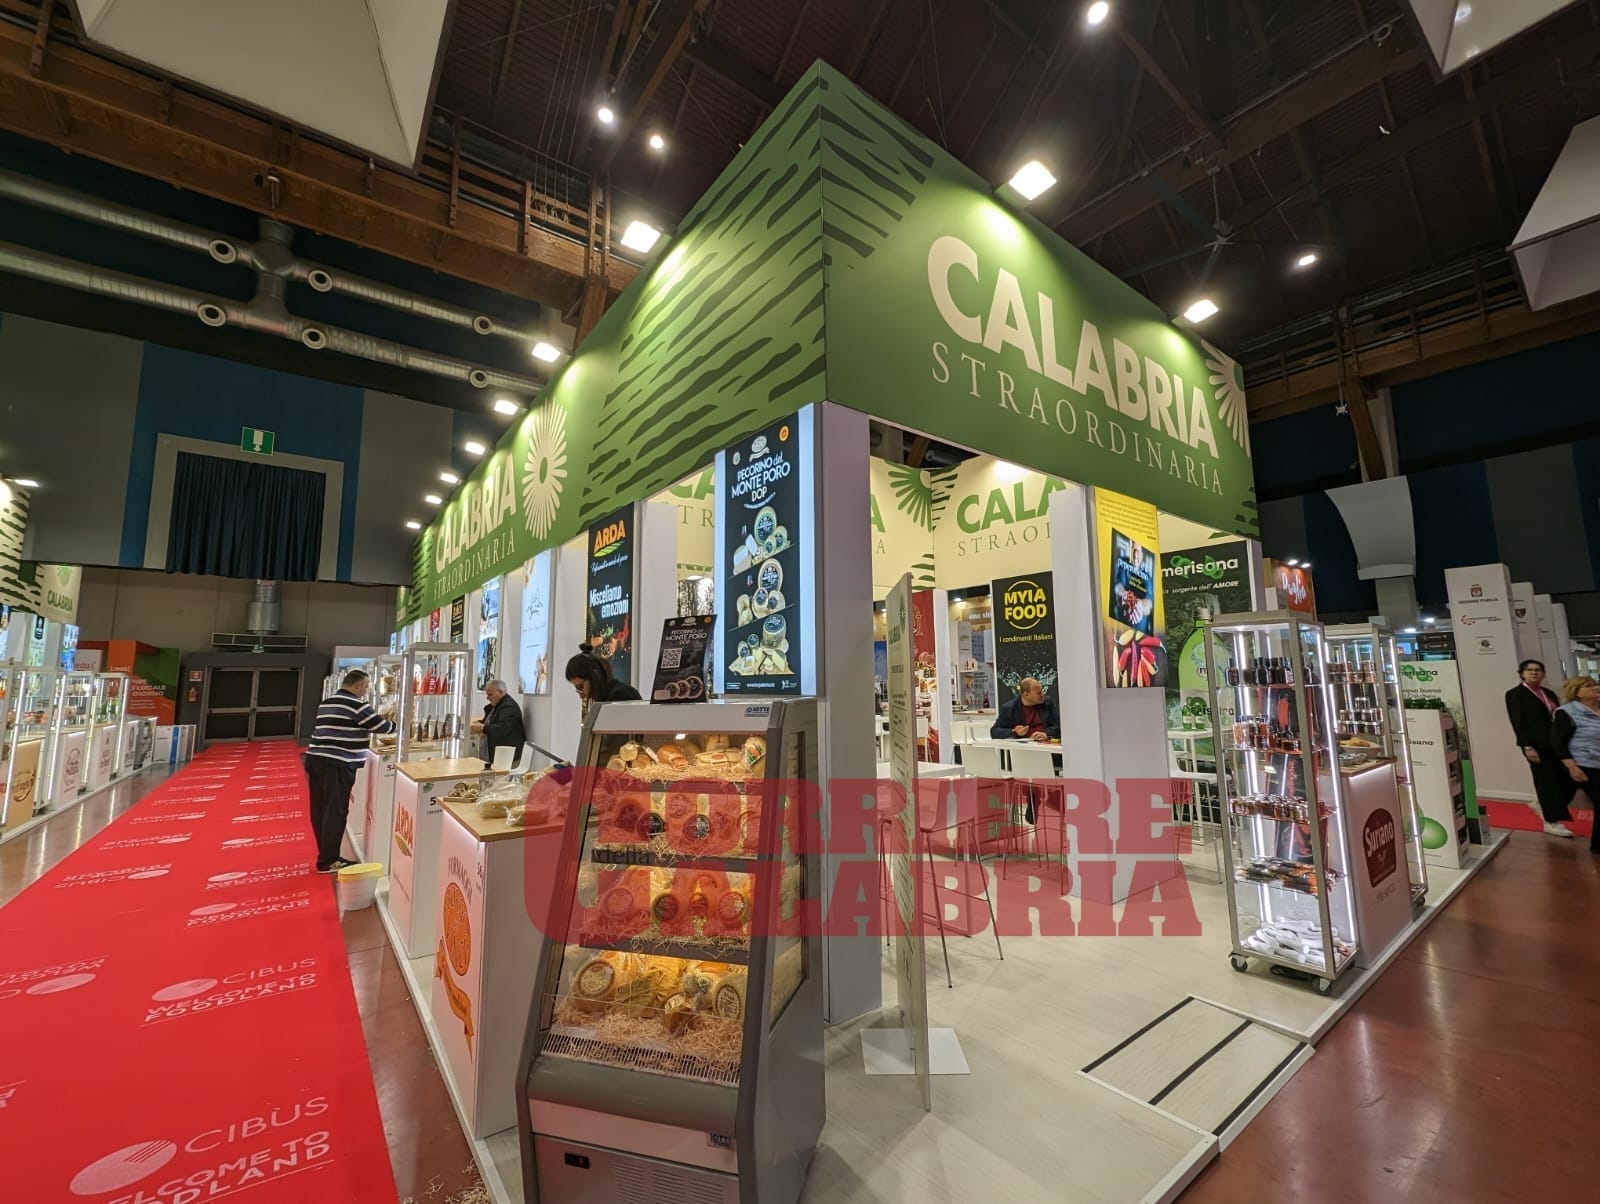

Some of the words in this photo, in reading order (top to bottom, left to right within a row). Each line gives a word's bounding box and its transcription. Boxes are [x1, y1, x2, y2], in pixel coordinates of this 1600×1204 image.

[928, 236, 1219, 459] CALABRIA
[932, 341, 1223, 496] STRAORDINARIA
[731, 474, 762, 499] MONTE
[763, 461, 791, 485] PORO
[738, 457, 773, 482] PECORINO
[751, 486, 768, 502] DOP
[435, 452, 517, 573] CALABRIA
[593, 519, 626, 554] ARDA
[433, 527, 515, 601] STRAORDINARIA
[1004, 588, 1046, 605] MYIA
[1213, 580, 1240, 589] AMORE
[601, 593, 629, 618] emozioni
[1004, 604, 1048, 622] FOOD
[394, 801, 413, 850] ARDA
[1364, 821, 1394, 857] Suriano
[240, 891, 310, 907] CIBUS
[222, 958, 316, 984] CIBUS
[143, 977, 316, 1023] FOODLAND
[146, 979, 279, 1015] WELCOME
[184, 1097, 329, 1153] CIBUS
[108, 1148, 272, 1204] ELCOME
[282, 1131, 330, 1154] TO
